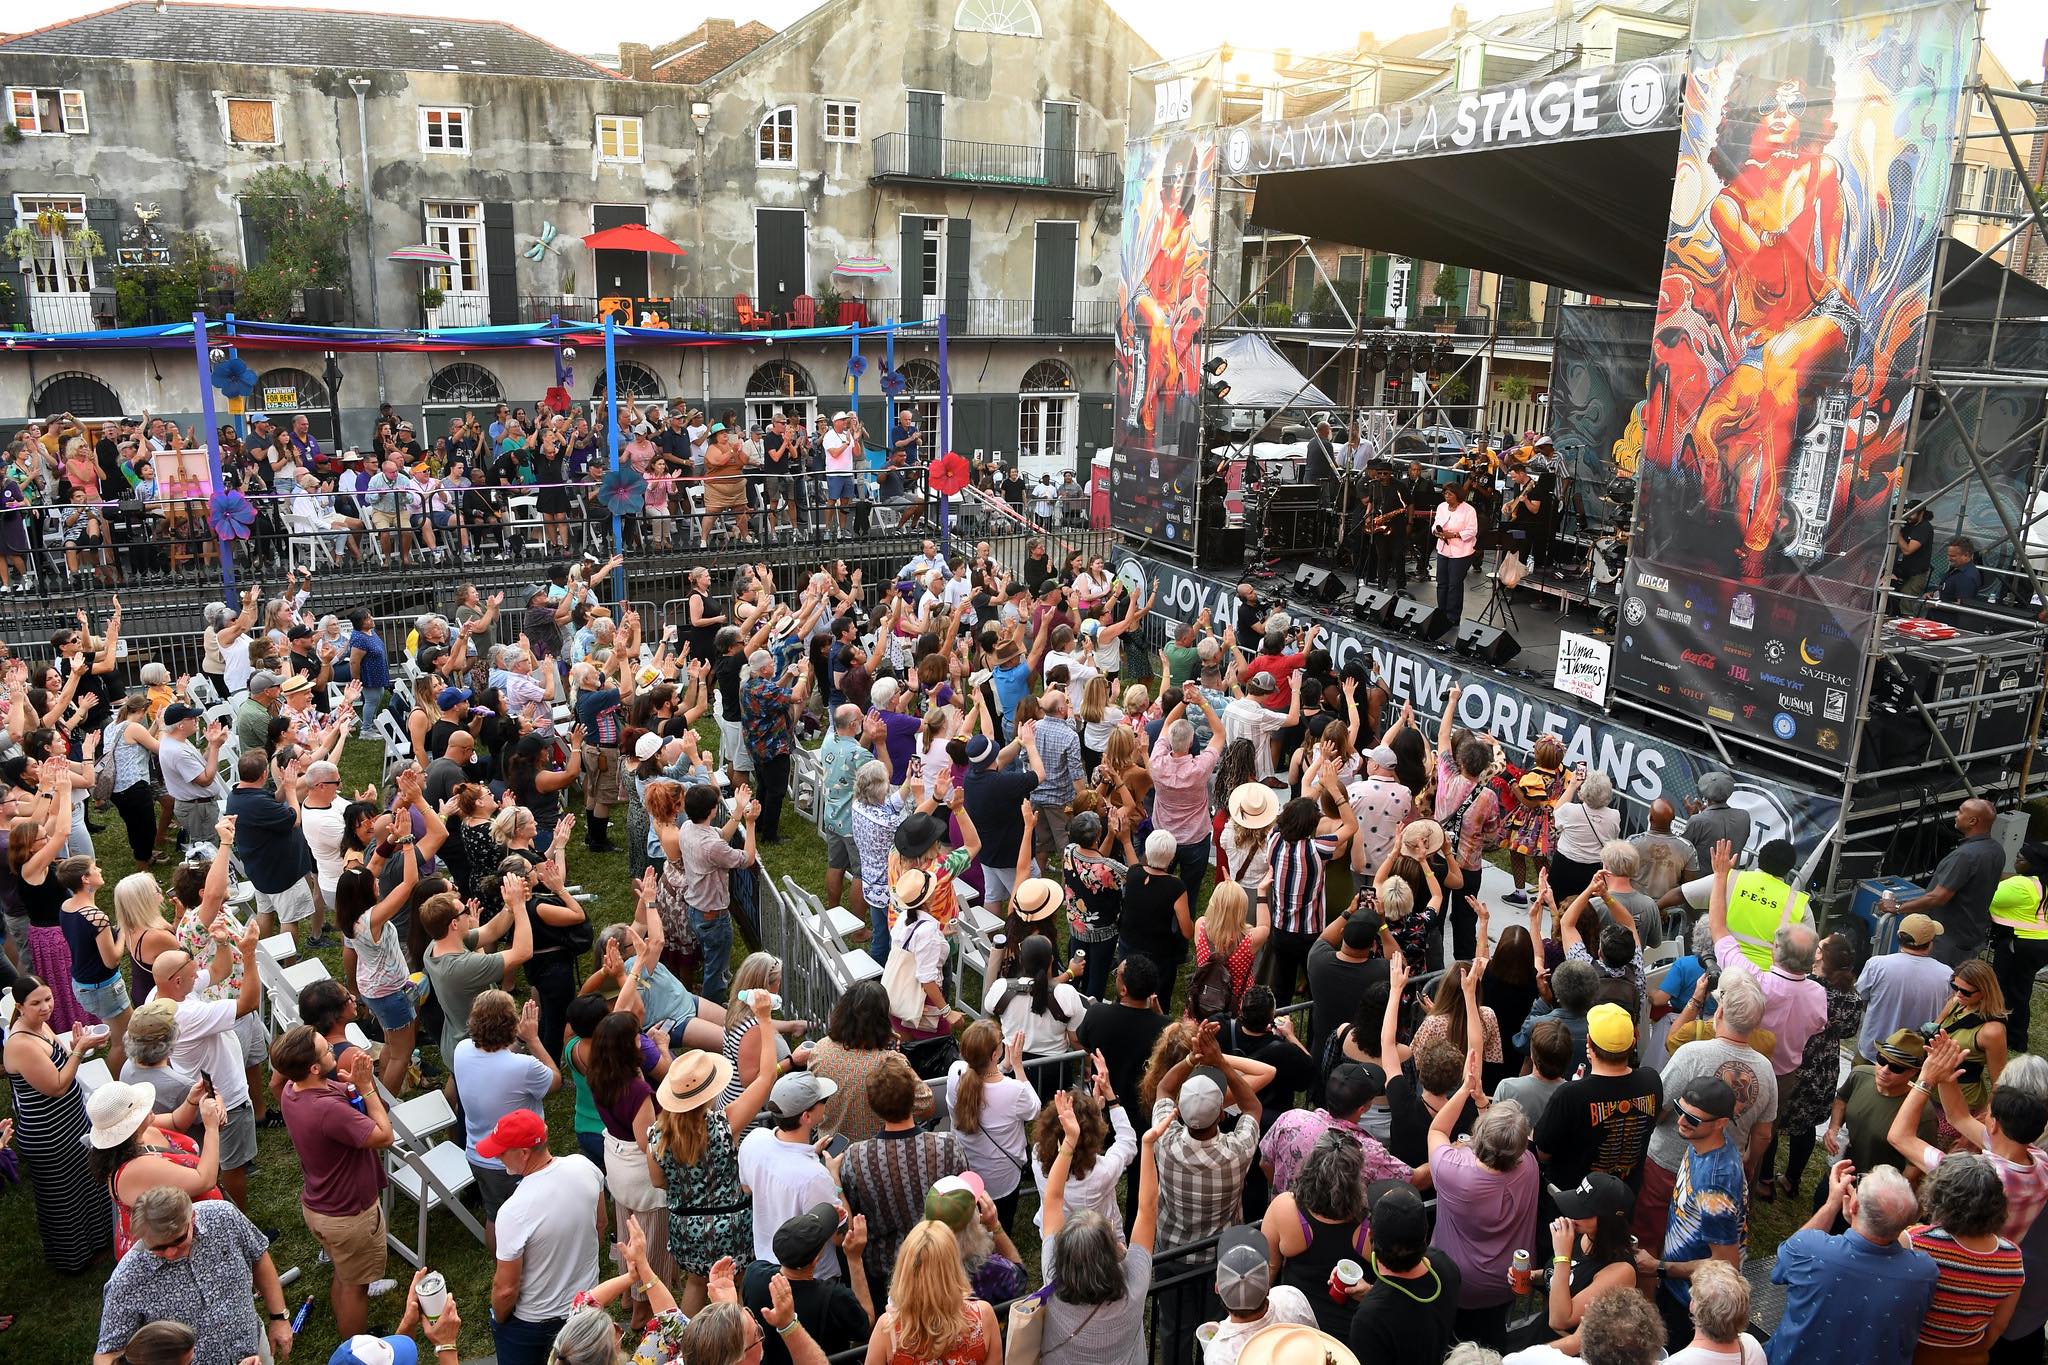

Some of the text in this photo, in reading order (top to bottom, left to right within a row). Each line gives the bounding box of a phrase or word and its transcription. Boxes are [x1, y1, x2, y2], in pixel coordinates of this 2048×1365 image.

[1259, 105, 1440, 169] JAMNOLA
[1450, 75, 1601, 146] STAGE
[266, 393, 295, 402] FOR RENT
[1638, 573, 1669, 590] NOCCA
[1163, 574, 1210, 616] JOY
[1564, 657, 1605, 686] Thomas
[1727, 664, 1750, 682] JBL
[1760, 672, 1785, 686] WHERE
[1800, 666, 1852, 687] SAZERAC
[1778, 693, 1814, 715] LOUISIANA
[1371, 647, 1452, 713] NEW
[1458, 684, 1666, 800] ORLEANS
